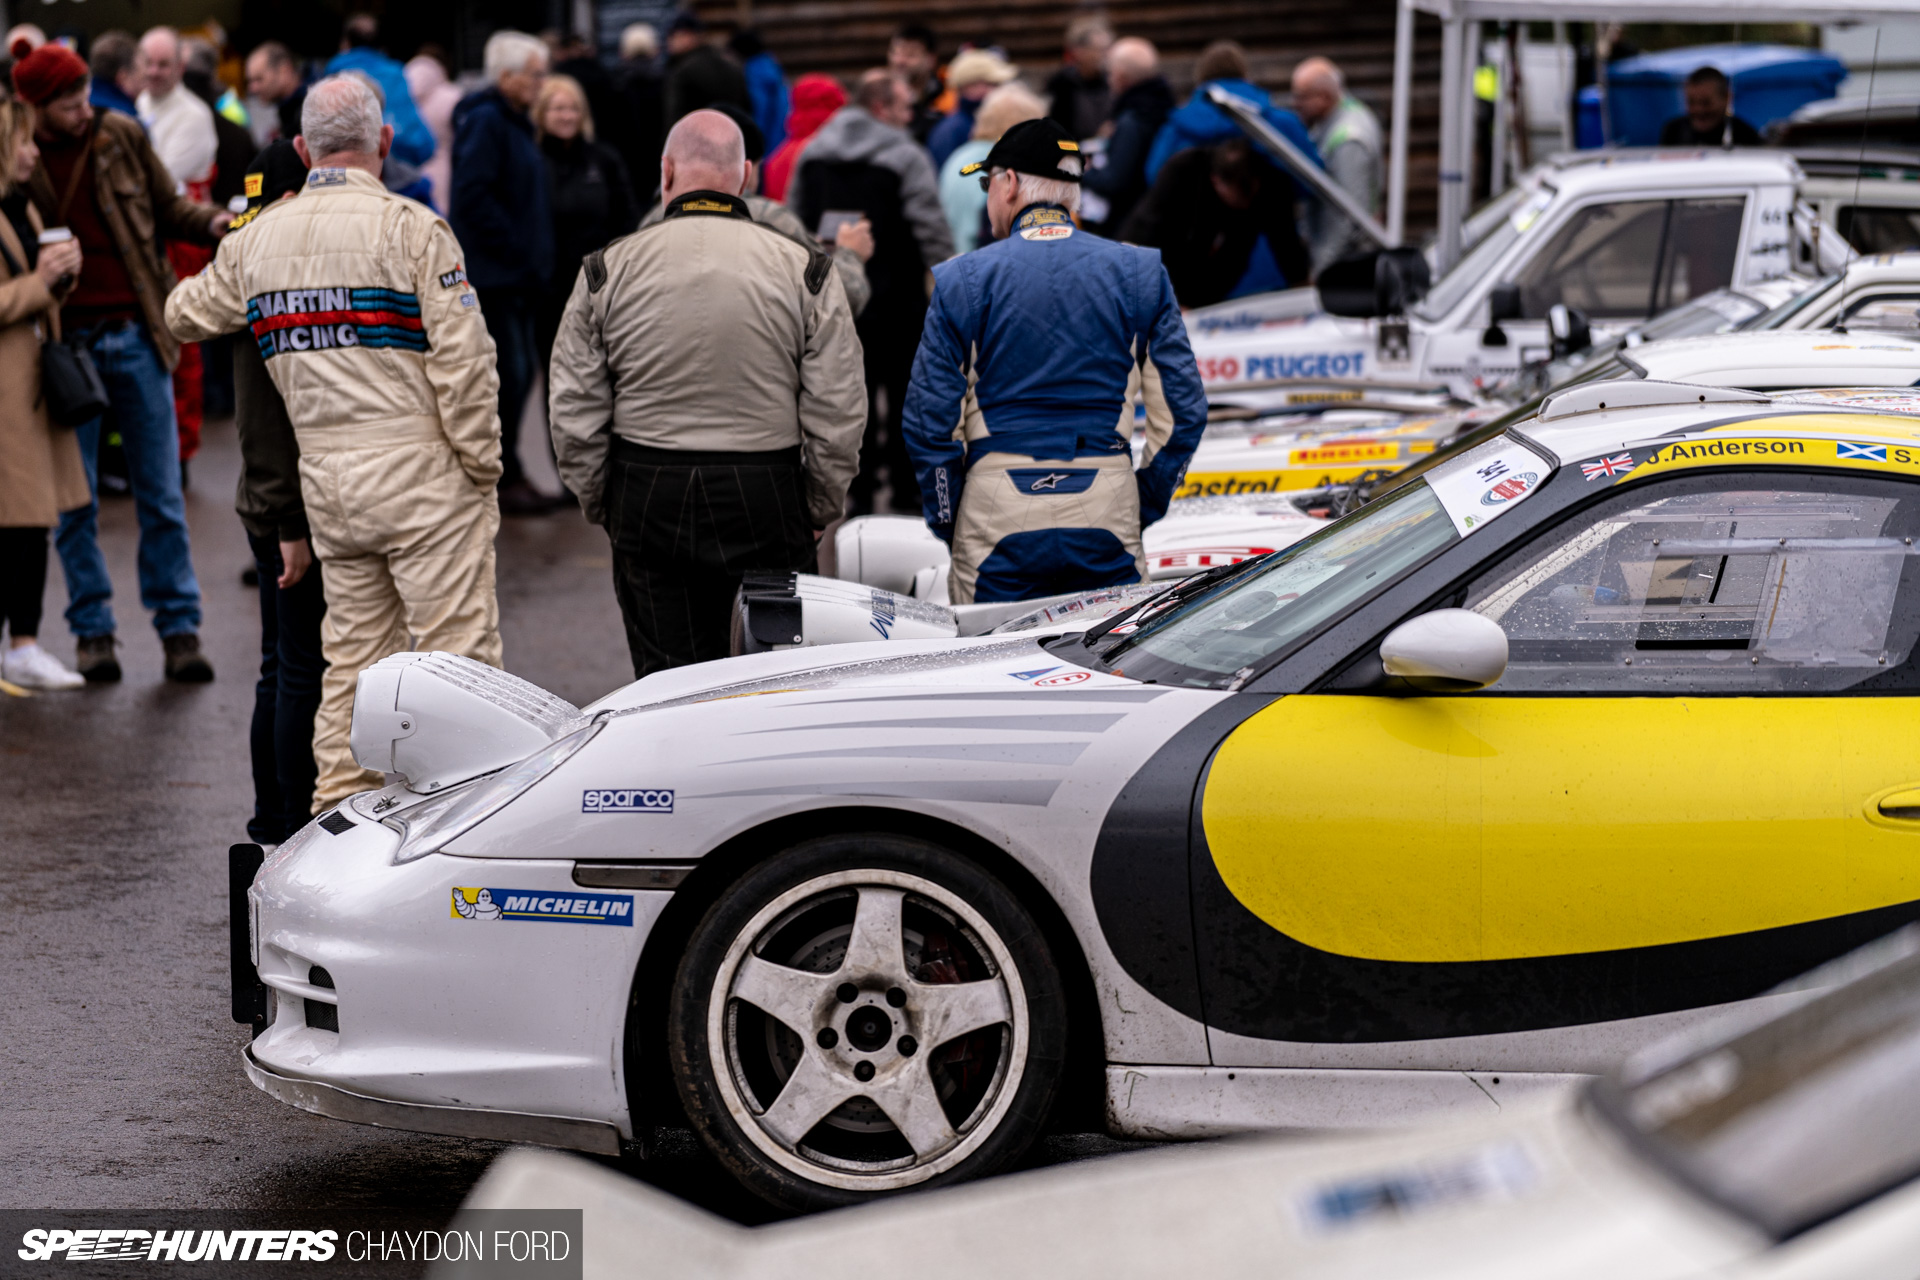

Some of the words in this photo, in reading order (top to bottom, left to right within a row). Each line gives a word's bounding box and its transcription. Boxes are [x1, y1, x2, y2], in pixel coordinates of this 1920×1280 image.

[441, 270, 466, 288] MA
[256, 287, 352, 318] MARTINI
[1245, 352, 1364, 379] PEUGEOT
[1646, 439, 1805, 465] J.Anderson
[1178, 474, 1282, 498] astrol
[584, 790, 673, 812] sparco
[503, 896, 631, 916] MICHELIN
